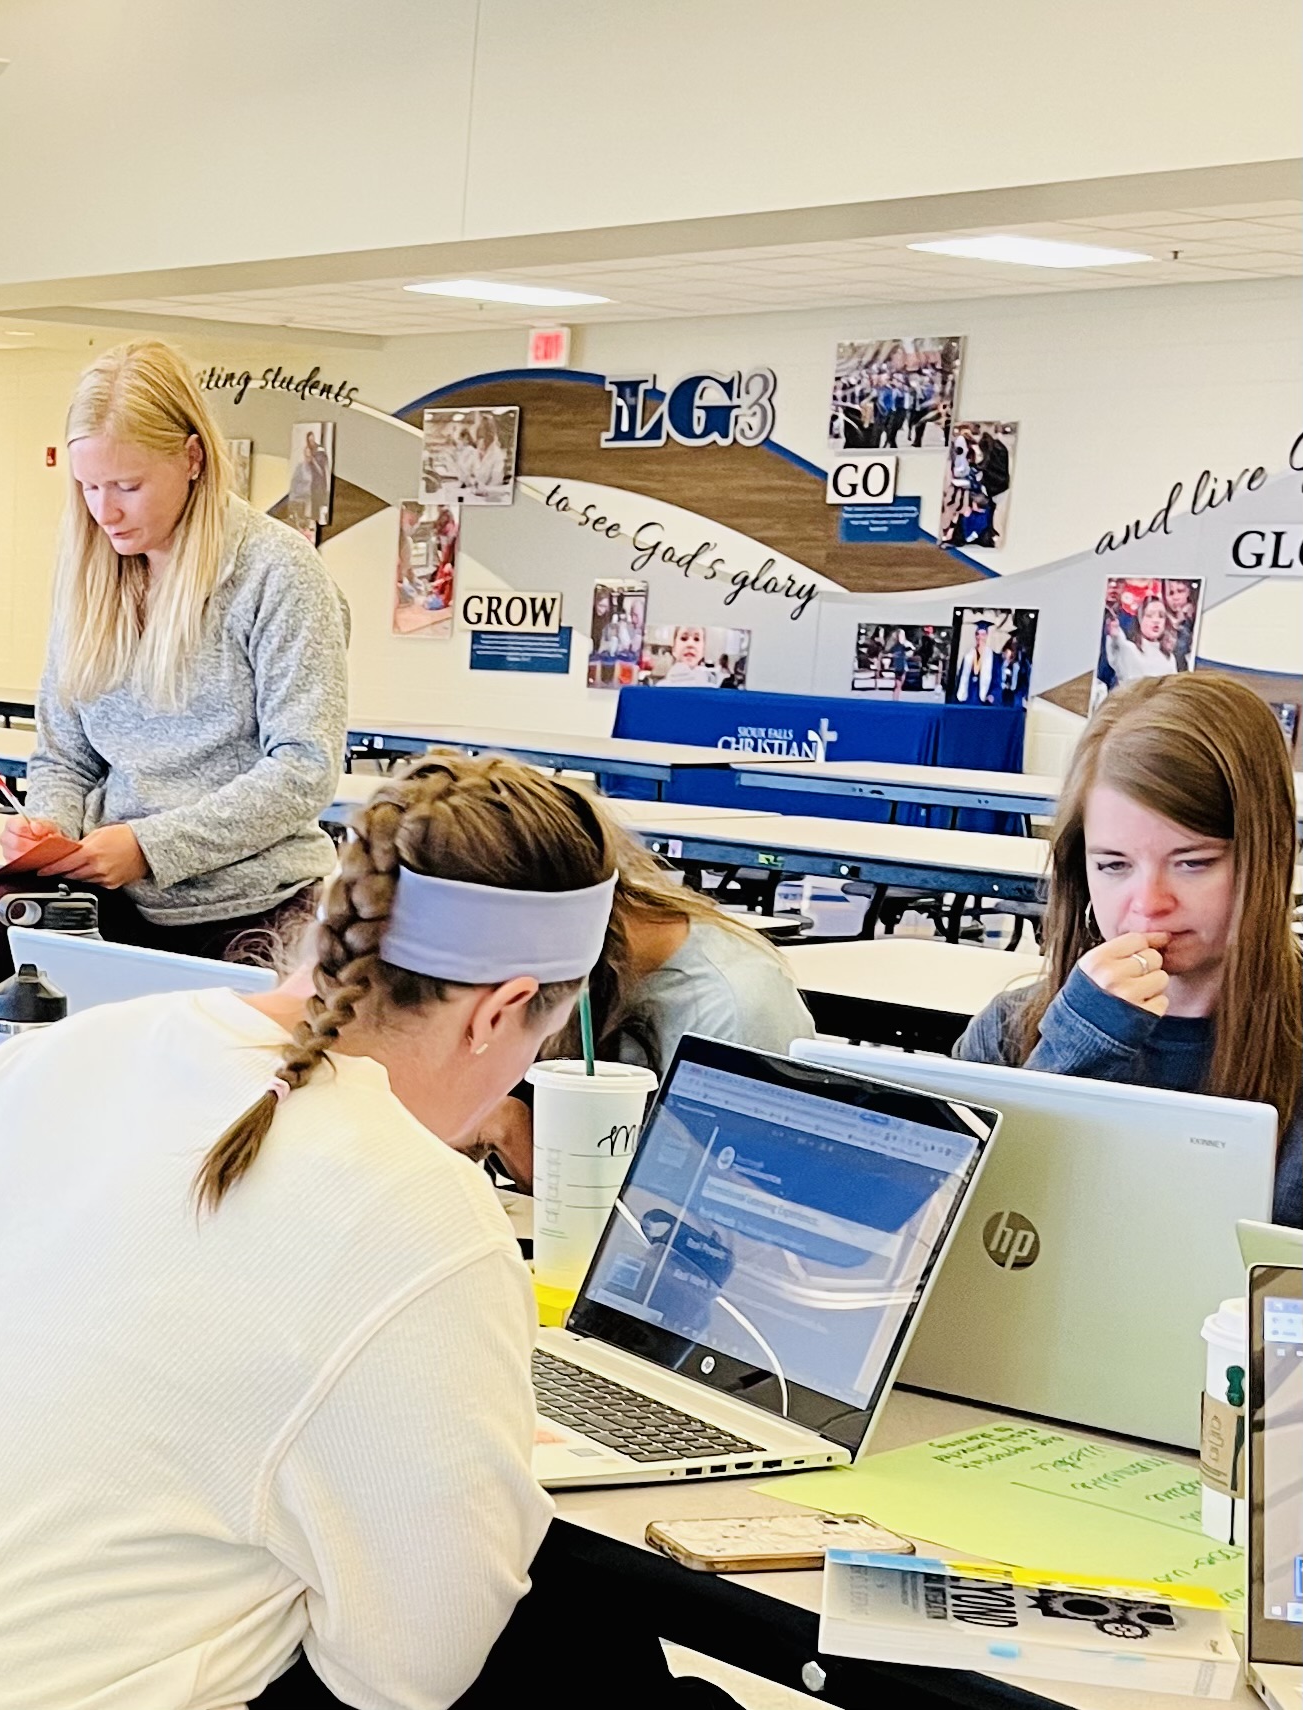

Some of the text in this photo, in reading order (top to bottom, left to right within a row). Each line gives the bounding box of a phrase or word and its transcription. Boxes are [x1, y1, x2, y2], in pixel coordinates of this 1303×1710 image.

[259, 366, 359, 408] students
[601, 368, 777, 448] LG3
[832, 462, 891, 498] GO
[1094, 466, 1268, 556] and live
[545, 484, 820, 621] to see God's glory
[1231, 530, 1303, 570] GL
[462, 595, 558, 627] GROW
[717, 735, 818, 761] CHRISTIAN
[767, 727, 794, 741] FALLS
[990, 1210, 1036, 1271] hp
[949, 1571, 1019, 1629] YOND
